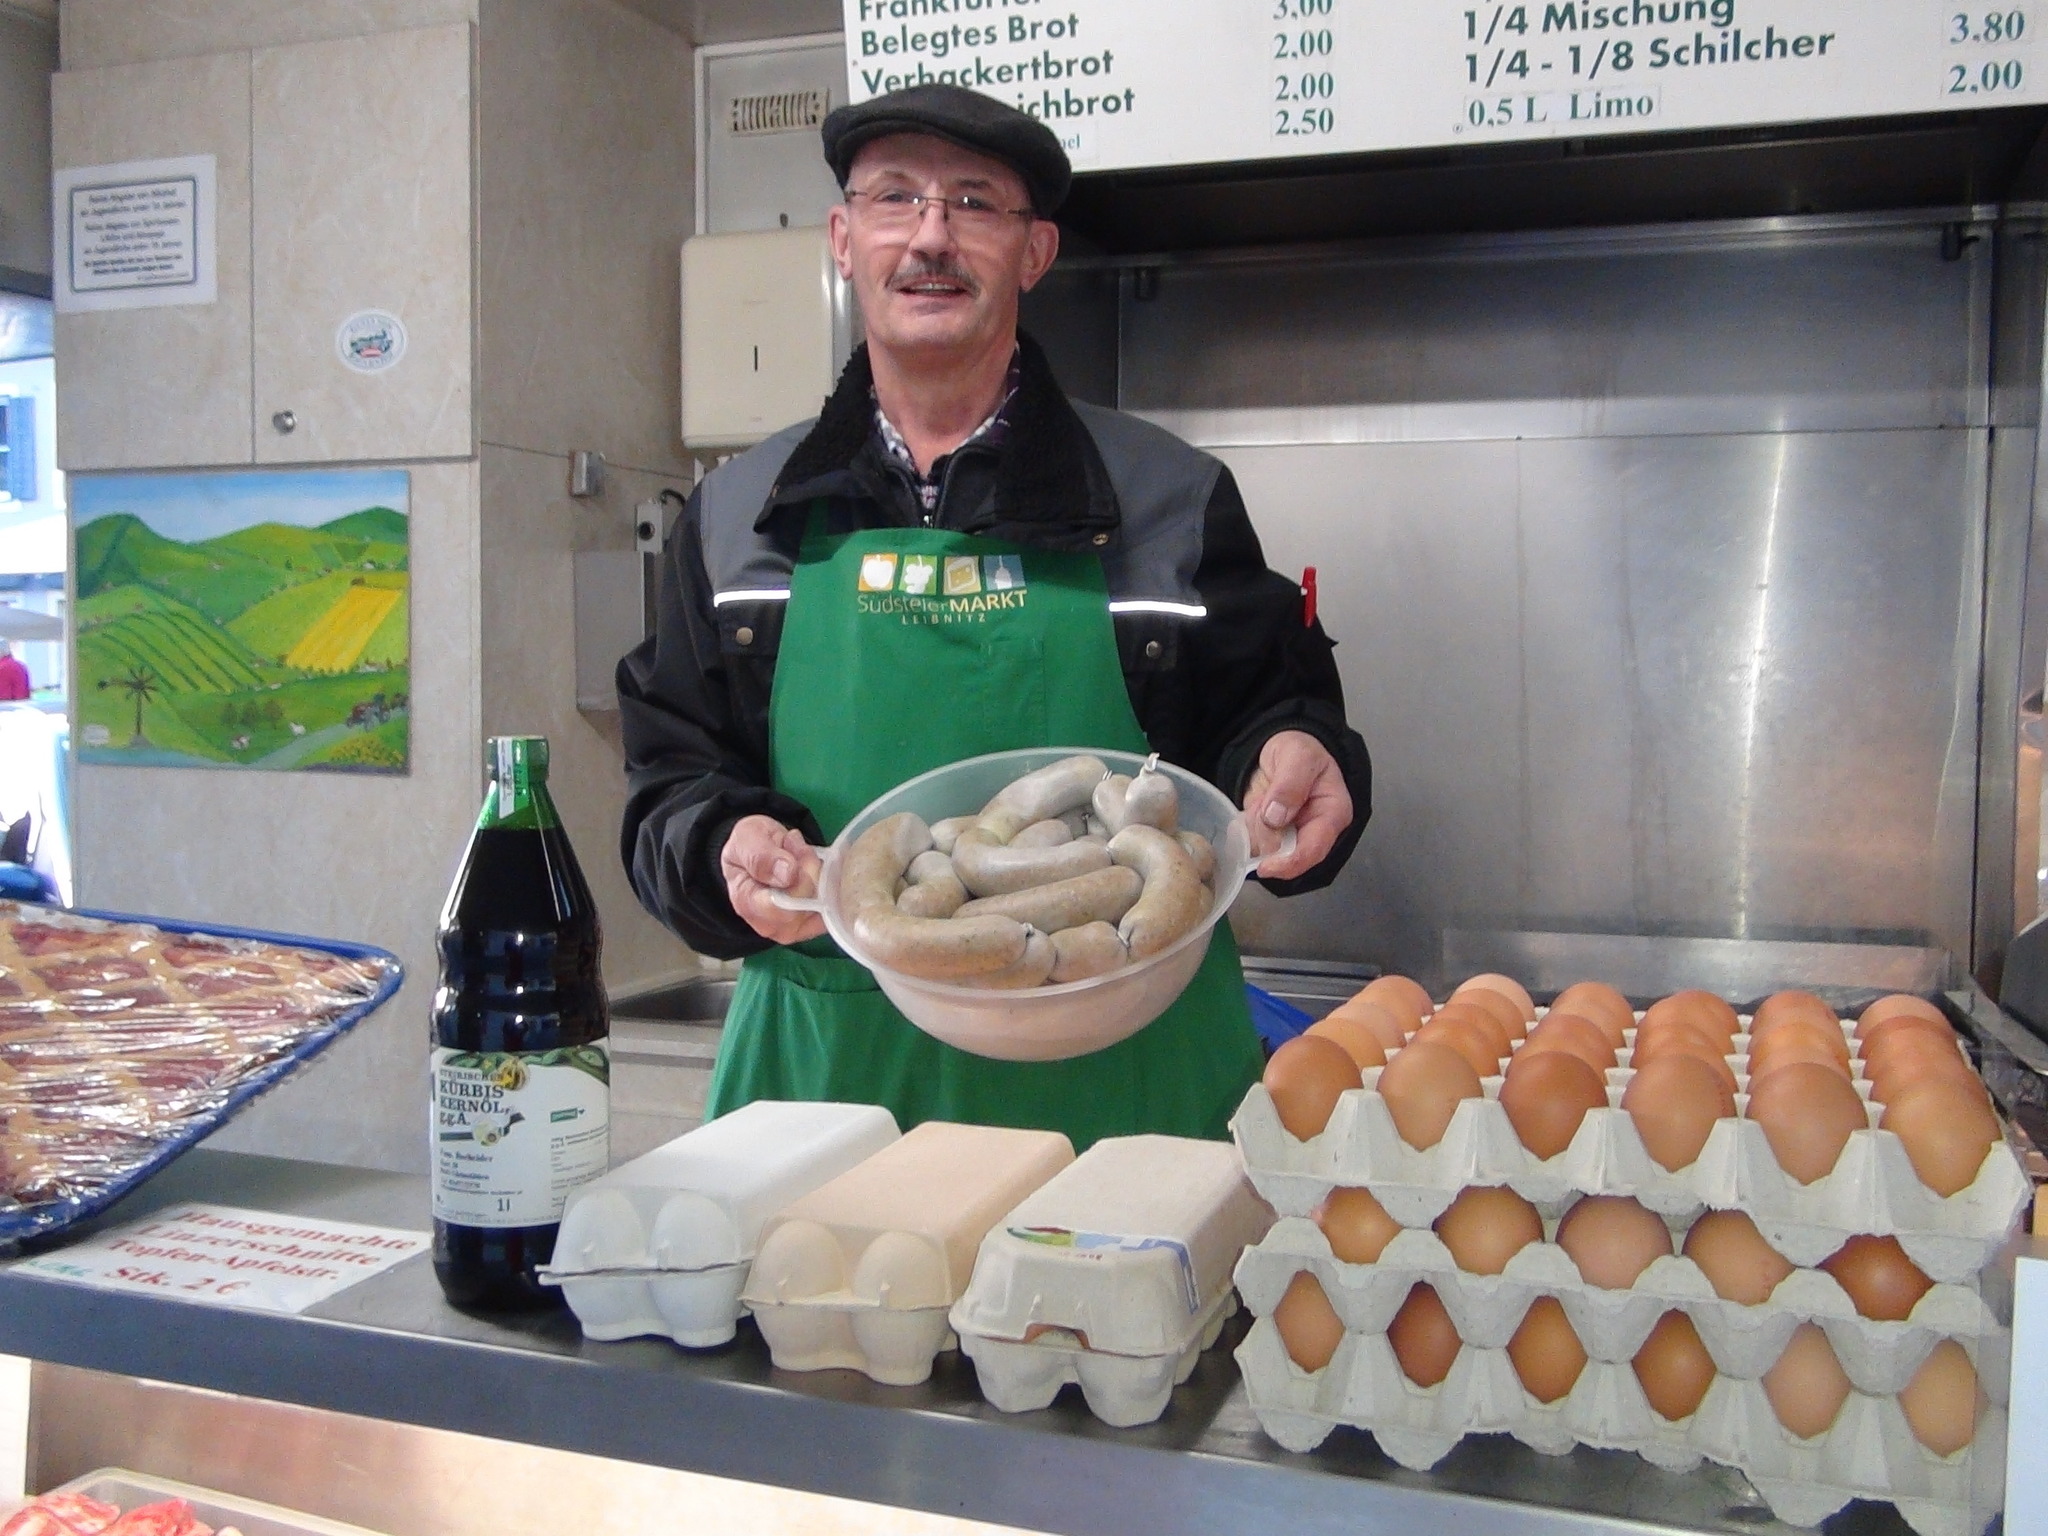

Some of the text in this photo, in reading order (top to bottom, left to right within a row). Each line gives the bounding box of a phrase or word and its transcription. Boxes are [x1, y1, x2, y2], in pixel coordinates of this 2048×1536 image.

[861, 13, 1079, 58] Belegtes Brot
[1464, 0, 1735, 45] 1/4 Mischung
[1274, 29, 1333, 59] 2,00
[1466, 25, 1836, 88] 1/4 - 1/8 Schilcher
[861, 50, 1114, 96] Verhackertbrot
[1275, 72, 1334, 102] 2,00
[1948, 59, 2023, 95] 2,00
[1275, 107, 1334, 137] 2,50
[1468, 92, 1654, 127] 0,5 L Limo
[135, 1224, 381, 1265] Linzerschnitte
[170, 1211, 418, 1249] Hausgemachte
[103, 1266, 171, 1286] Stk.
